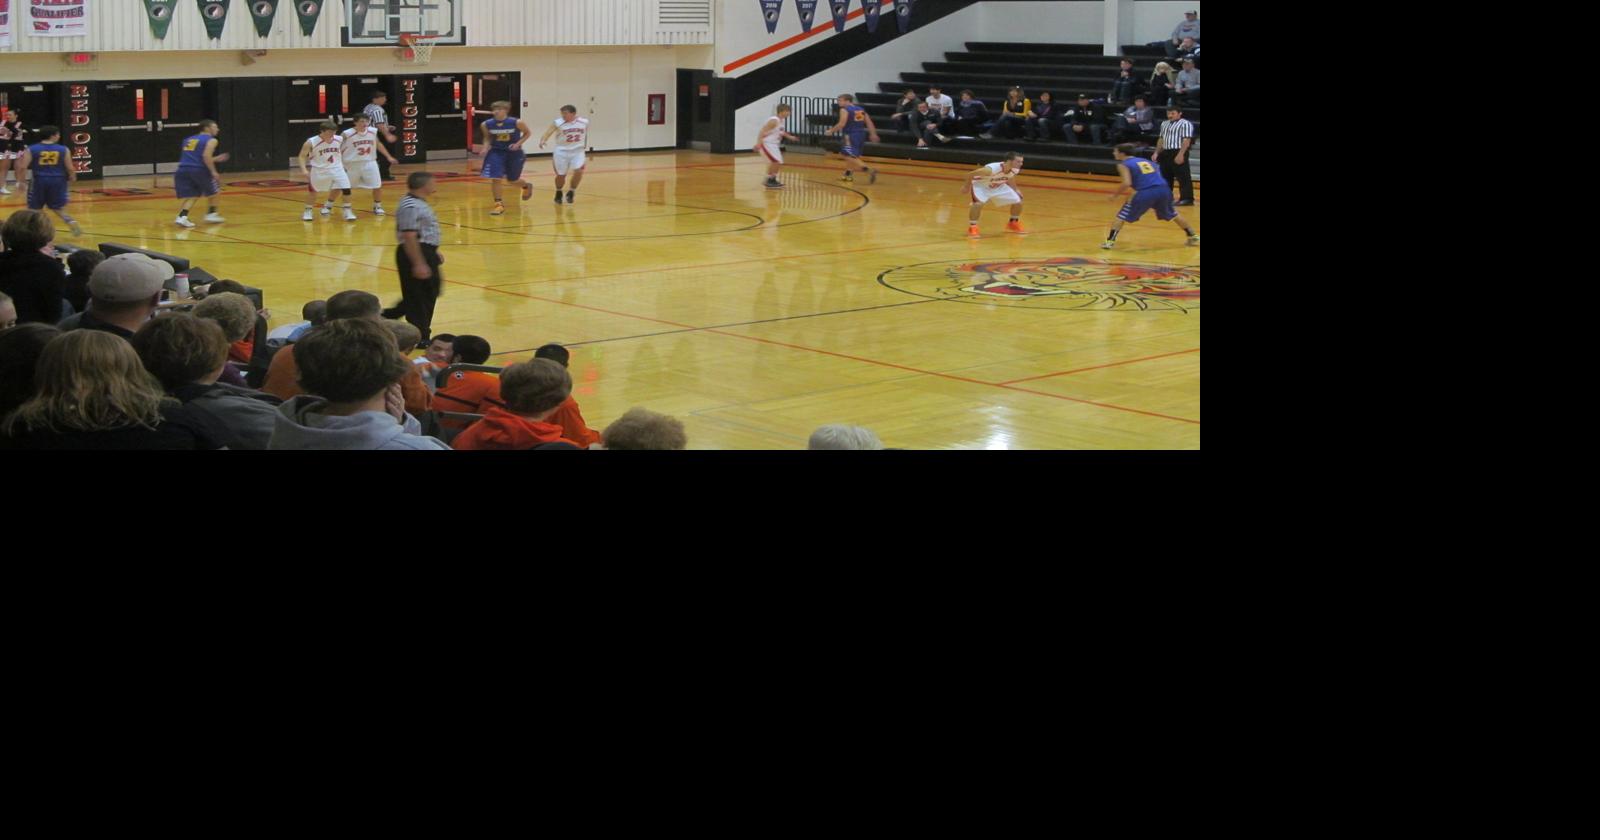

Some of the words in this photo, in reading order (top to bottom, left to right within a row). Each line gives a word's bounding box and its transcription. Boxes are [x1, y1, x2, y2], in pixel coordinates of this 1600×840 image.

[30, 6, 84, 18] QUALIFIER
[401, 79, 418, 157] TIGERS
[356, 146, 372, 156] 34
[39, 151, 60, 165] 23
[327, 154, 336, 164] 4
